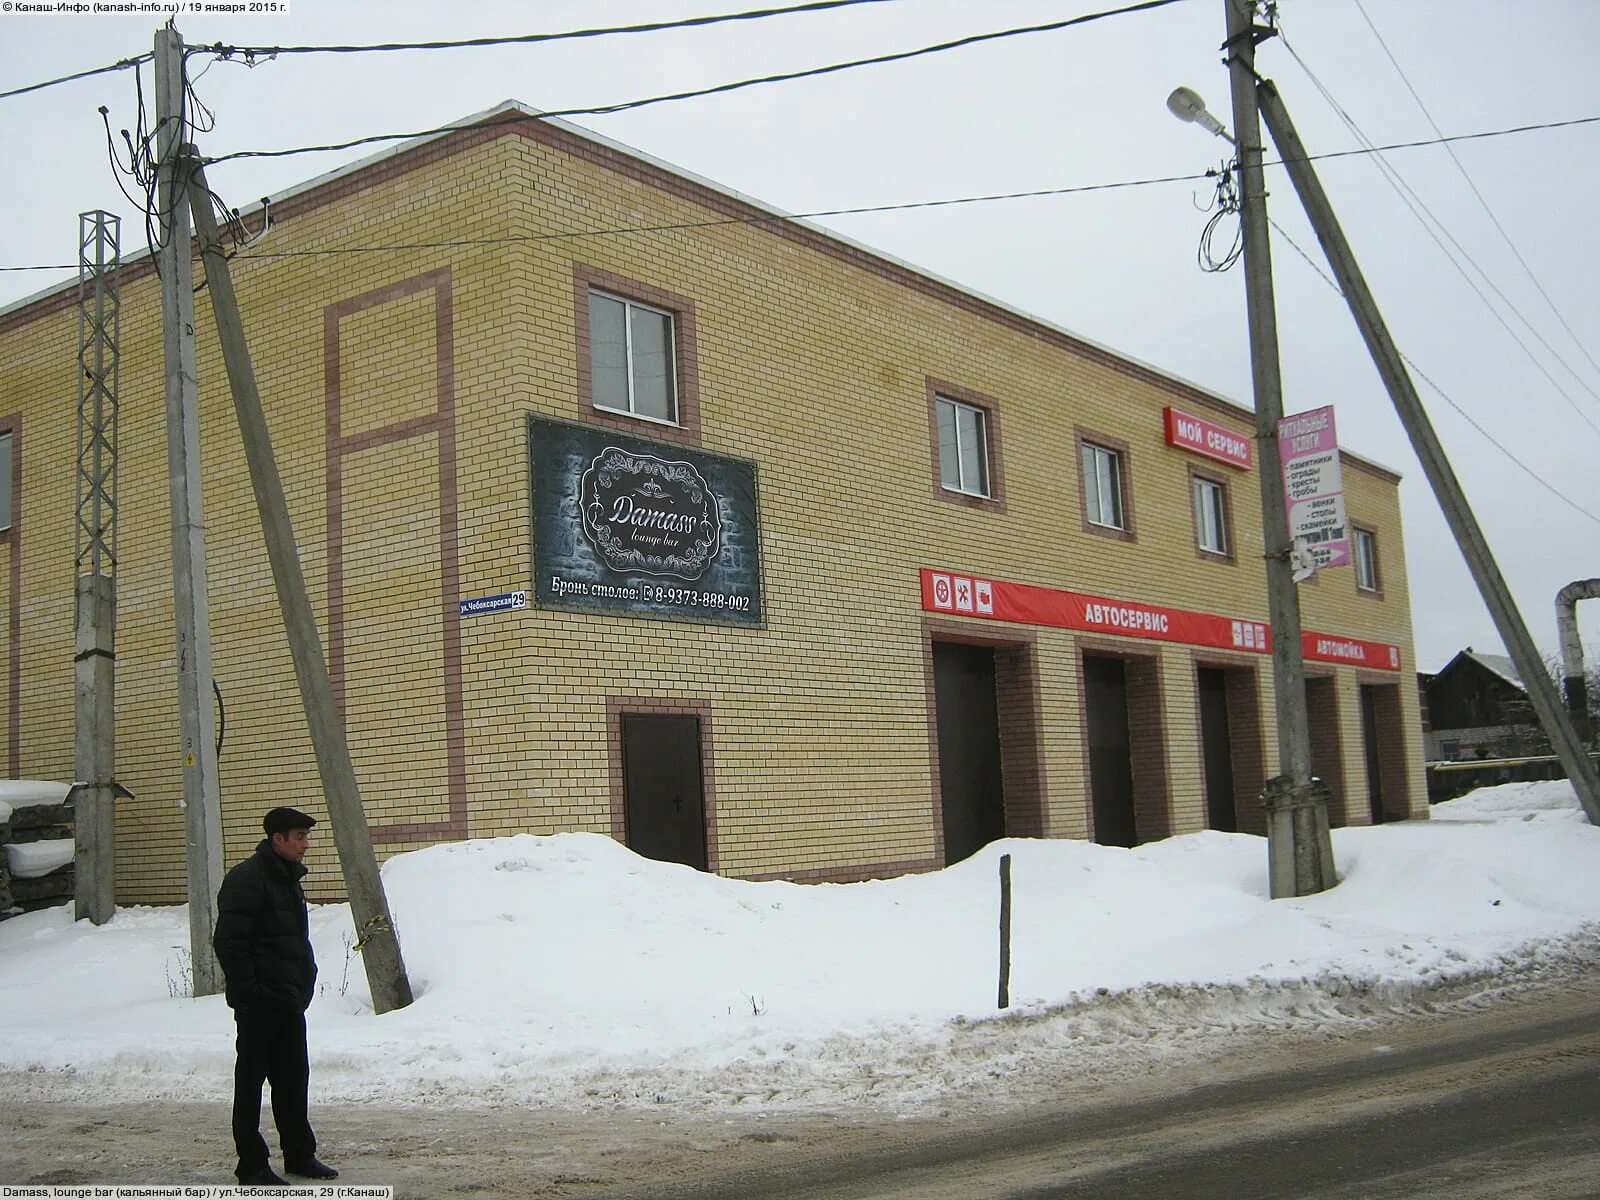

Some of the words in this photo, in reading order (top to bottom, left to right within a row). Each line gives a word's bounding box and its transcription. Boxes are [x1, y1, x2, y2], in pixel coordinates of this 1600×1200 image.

[1177, 419, 1203, 444] МОЙ
[1207, 430, 1249, 460] СЕРВИС
[1290, 455, 1332, 470] памятники
[1290, 467, 1321, 480] ограды
[1292, 476, 1321, 489] кресты
[1293, 485, 1318, 499] гробы
[1312, 497, 1335, 508] венки
[609, 494, 698, 535] Damass
[1300, 518, 1338, 531] скамейки
[631, 530, 662, 548] lounge
[663, 531, 679, 547] bar
[512, 593, 525, 606] 29
[551, 576, 589, 598] Бронь
[591, 585, 639, 600] столов:
[655, 586, 751, 612] 8-9373-888-002
[1085, 602, 1169, 634] АВТОСЕРВИС
[1316, 639, 1365, 660] АВТОМОЙКА
